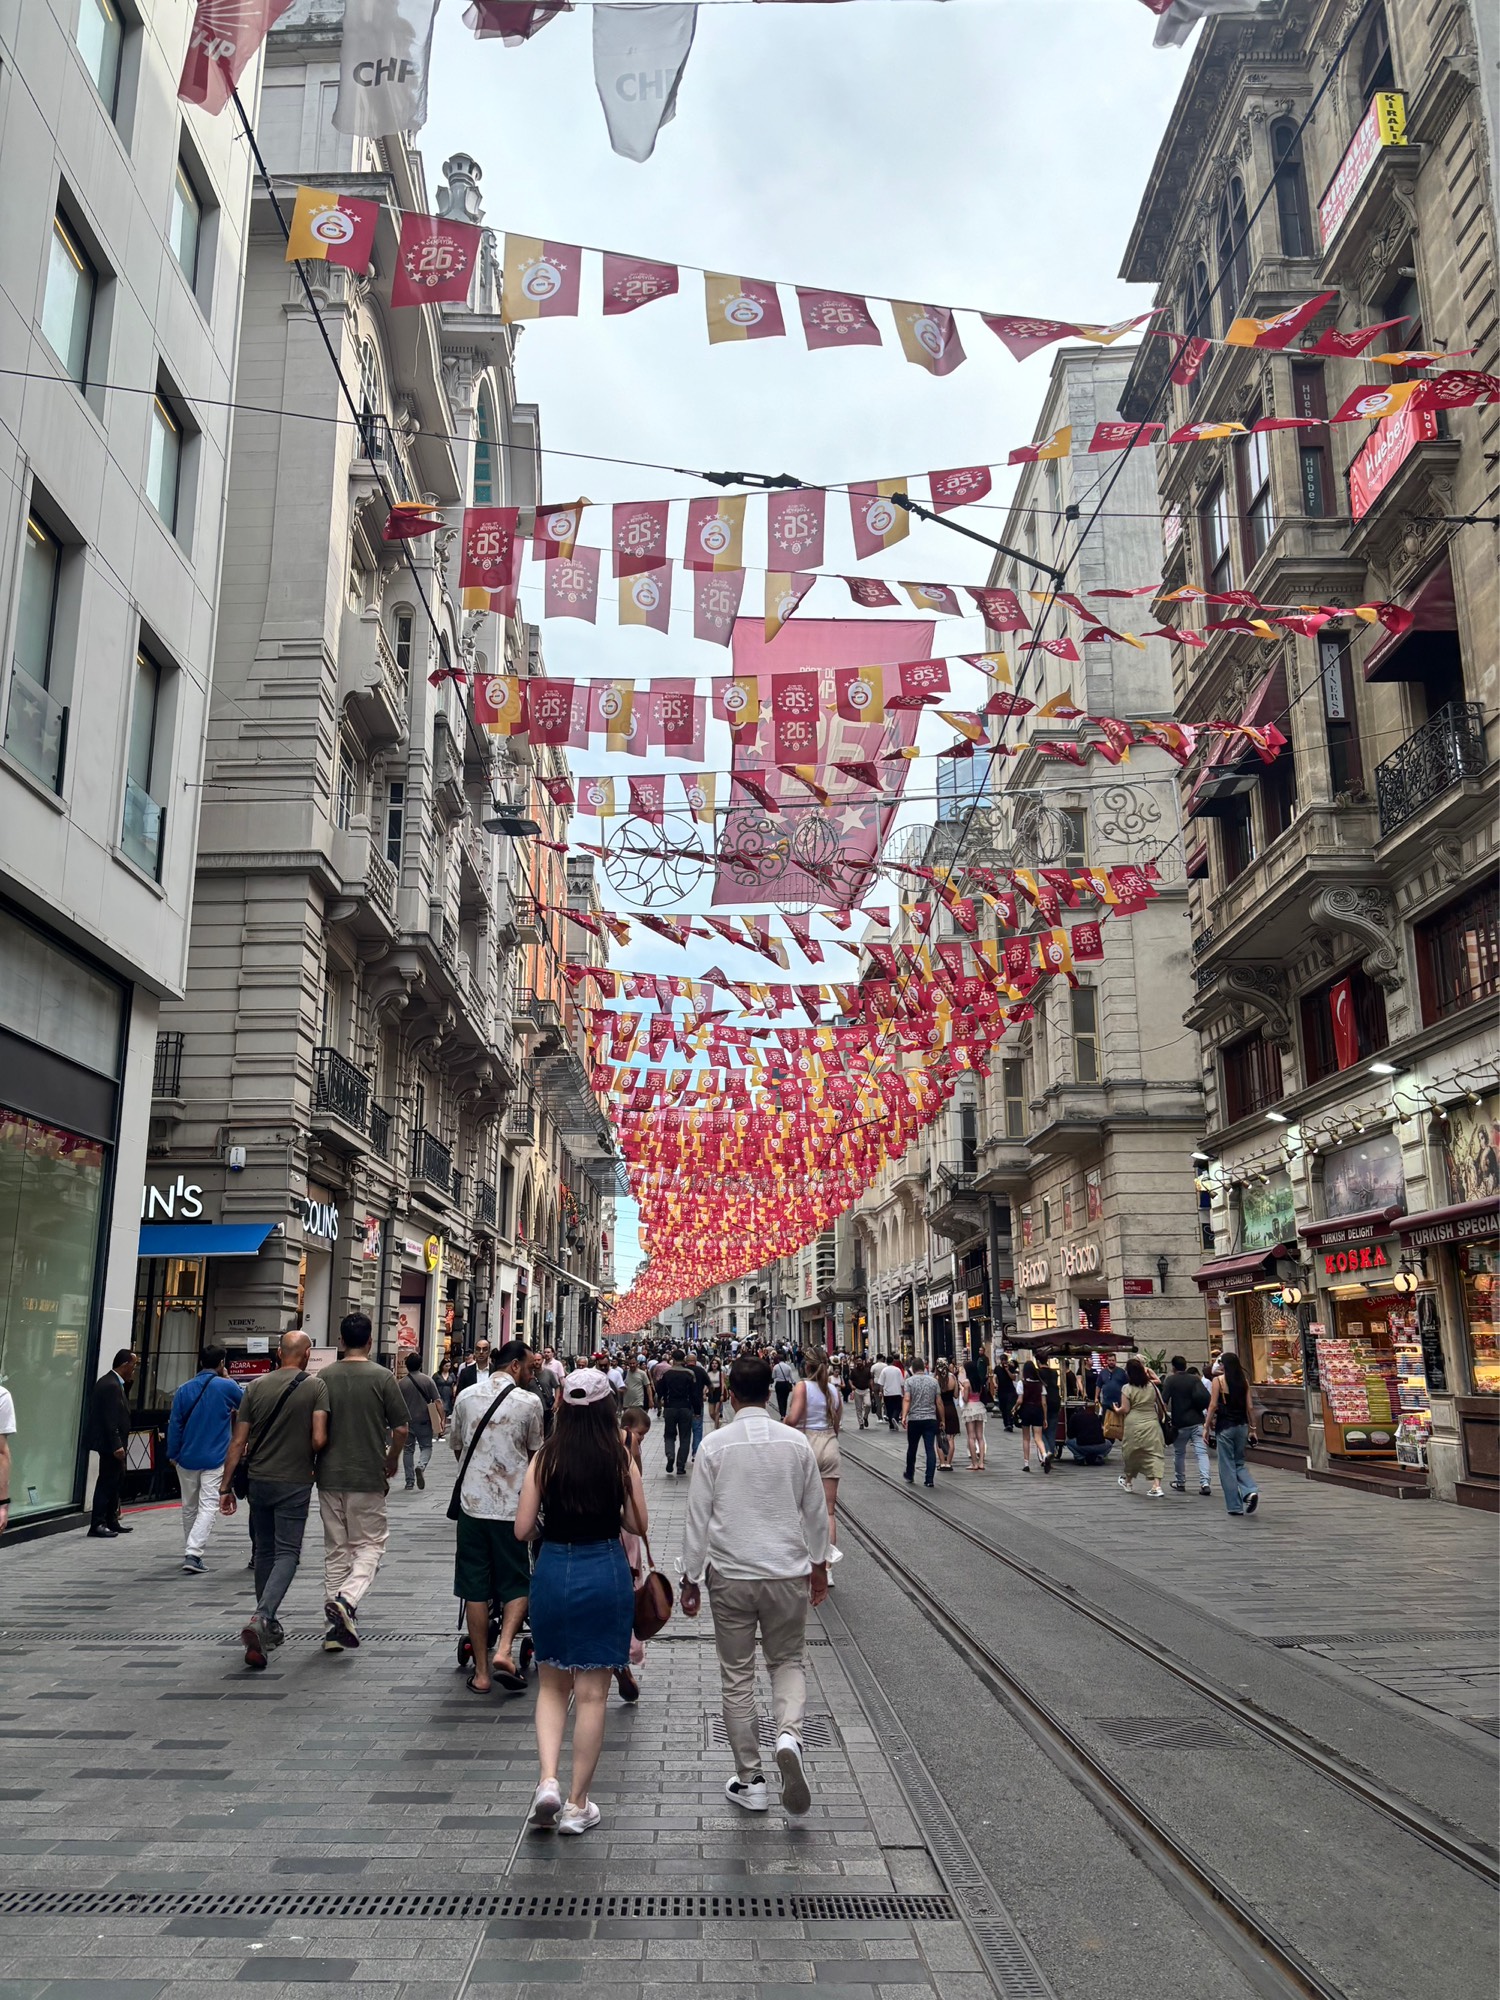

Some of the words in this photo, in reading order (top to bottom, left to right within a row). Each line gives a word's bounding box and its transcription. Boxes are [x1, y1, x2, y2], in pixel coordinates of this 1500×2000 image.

[191, 26, 236, 61] HP
[352, 57, 419, 87] CHP
[419, 247, 454, 270] 26
[626, 281, 657, 296] 26
[821, 308, 855, 323] 26
[1013, 322, 1049, 334] 26
[1302, 384, 1312, 432] Huebr
[1420, 383, 1432, 437] Hber
[1365, 412, 1405, 479] Hueber
[1305, 458, 1315, 506] Hueber
[561, 568, 584, 590] 26
[709, 589, 730, 612] 26
[986, 601, 1010, 616] 26
[787, 722, 806, 739] 26
[1117, 884, 1132, 897] 26
[303, 1198, 339, 1241] COLIN'S
[1321, 1230, 1346, 1244] TURKISH
[1348, 1225, 1374, 1240] DELIGHT
[1409, 1223, 1454, 1246] TURKISH
[1060, 1239, 1099, 1277] DeFacto
[1324, 1244, 1387, 1275] KOSKA
[1018, 1255, 1049, 1288] DeFacto
